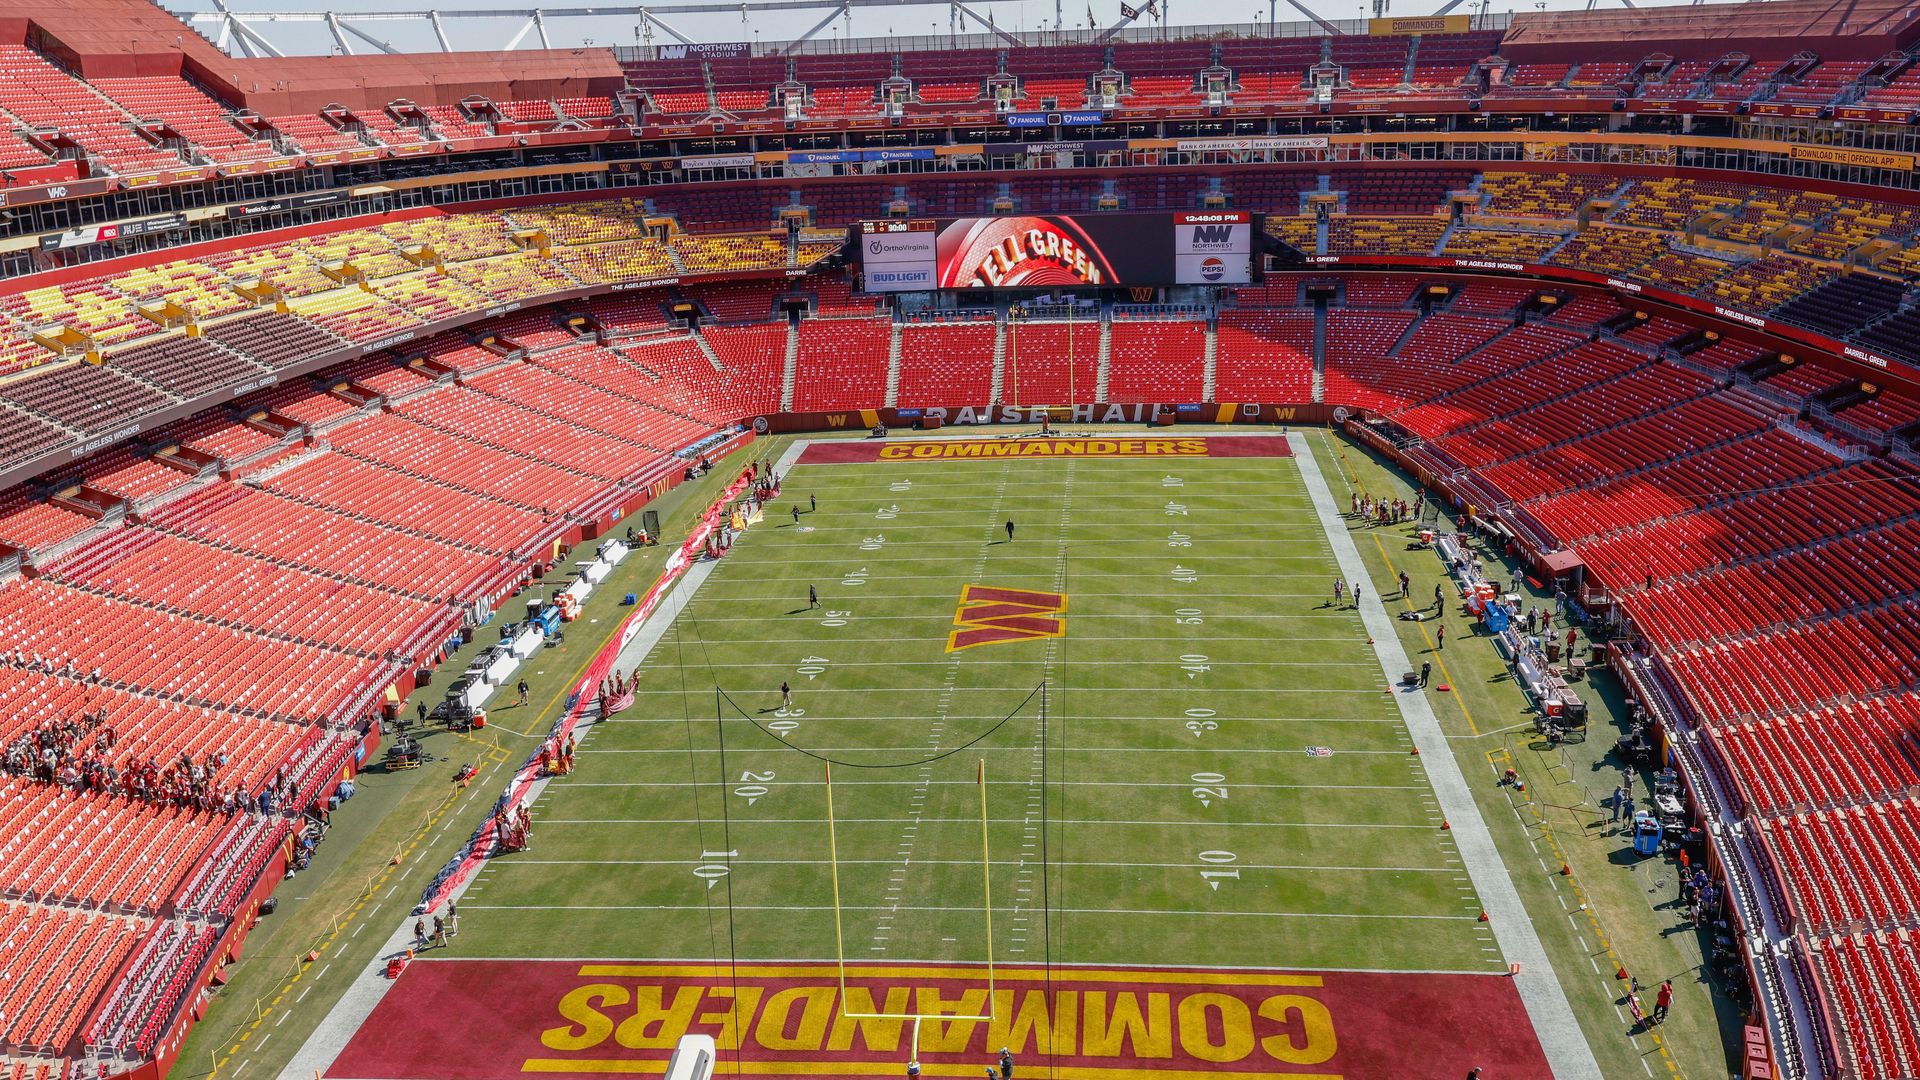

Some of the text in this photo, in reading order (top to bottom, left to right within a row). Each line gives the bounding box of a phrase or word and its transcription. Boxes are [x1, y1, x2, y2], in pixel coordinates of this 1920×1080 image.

[1392, 20, 1445, 31] COMMANDERS
[690, 43, 748, 53] NORTHWEST
[702, 51, 738, 59] STADIUM
[684, 158, 753, 168] Paycor Paycor Paycor
[1797, 149, 1833, 160] DOWNLOAD
[1834, 152, 1847, 161] THE
[1850, 154, 1879, 165] OFFICIAL
[1880, 156, 1895, 165] APP
[888, 224, 907, 232] 90:00
[1192, 225, 1233, 243] NW
[884, 244, 929, 252] OrthoVirginia
[1024, 229, 1102, 285] GREEN
[1468, 260, 1496, 268] AGELESS
[1497, 262, 1524, 271] WONDER
[624, 281, 651, 290] AGELESS
[652, 277, 679, 287] WONDER
[873, 272, 928, 282] BUD LIGHT
[1715, 306, 1765, 327] THE AGELESS WONDER
[362, 332, 415, 353] THE AGELESS WONDER
[1844, 347, 1888, 368] DARRELL GREEN
[234, 375, 278, 396] DARRELL GREEN
[71, 423, 140, 457] THE AGELESS WONDER
[879, 441, 1209, 459] COMMANDERS
[860, 538, 886, 550] 30
[1168, 534, 1193, 547] 30
[841, 571, 869, 586] 40
[1171, 569, 1198, 583] 40
[820, 610, 852, 627] 50
[1174, 608, 1204, 625] 50
[796, 656, 830, 674] 40
[1179, 654, 1211, 673] 40
[768, 707, 806, 731] 30
[1184, 708, 1219, 730] 30
[734, 770, 777, 798] 20
[1191, 772, 1229, 799] 20
[693, 849, 739, 878] 10
[1198, 850, 1241, 880] 10
[233, 898, 259, 942] CHAMPS
[540, 983, 1339, 1065] COMMANDERS
[171, 1019, 188, 1053] FIVE
